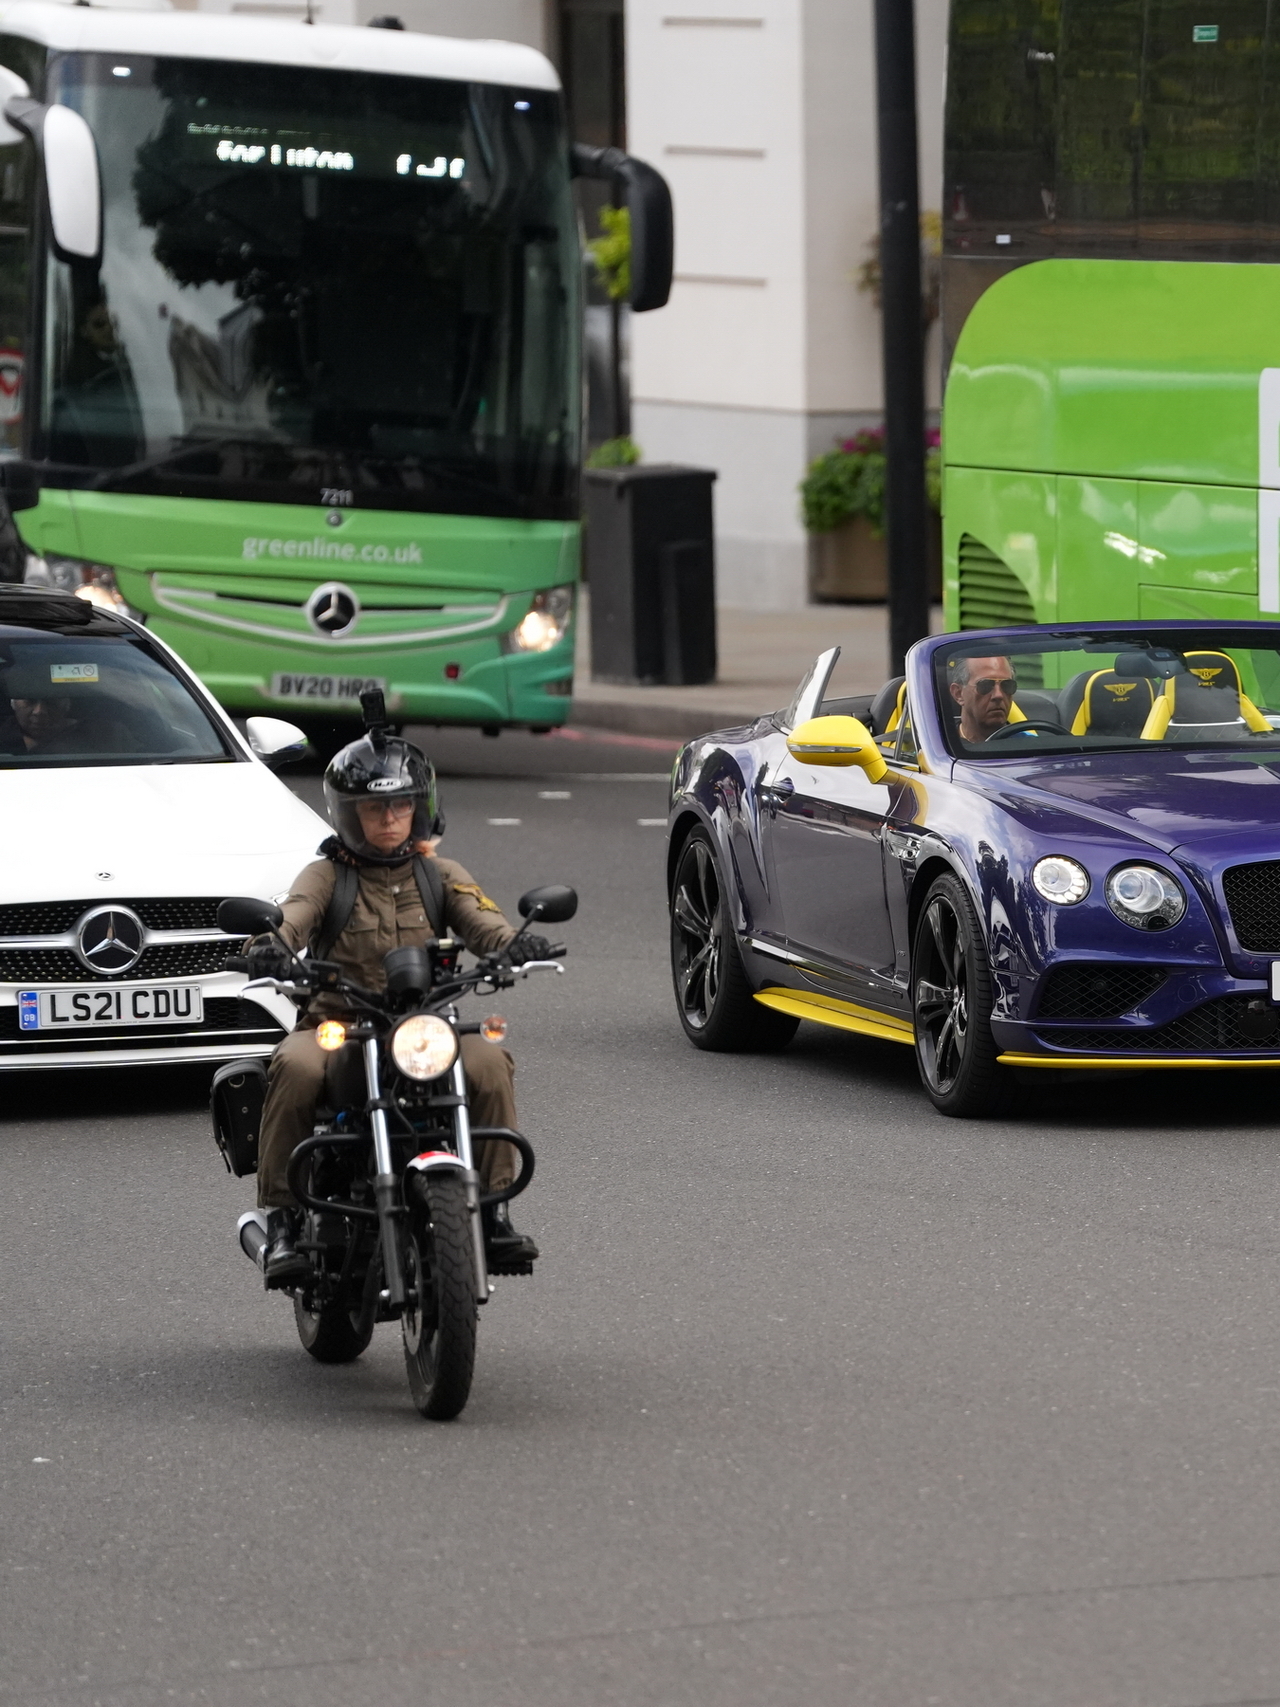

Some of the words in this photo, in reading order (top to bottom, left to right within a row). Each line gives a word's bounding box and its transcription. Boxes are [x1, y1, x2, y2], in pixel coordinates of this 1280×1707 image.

[242, 536, 423, 564] greenline.co.uk
[280, 674, 333, 698] BV20
[24, 1013, 35, 1022] GB
[50, 991, 122, 1023] LS21
[131, 988, 191, 1019] CDU
